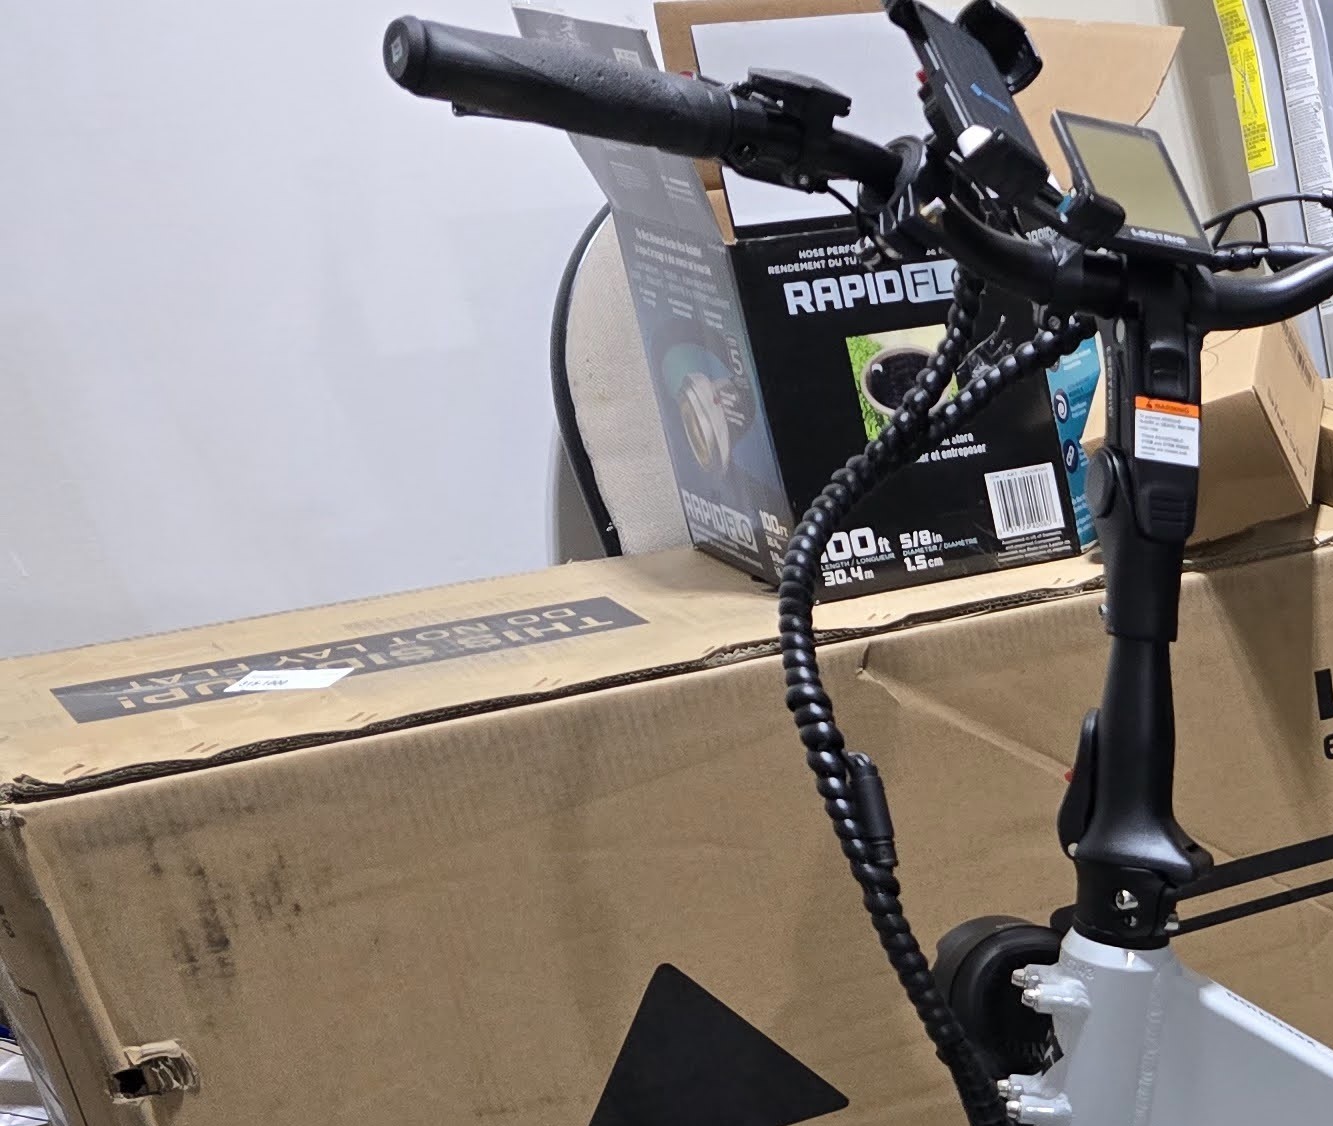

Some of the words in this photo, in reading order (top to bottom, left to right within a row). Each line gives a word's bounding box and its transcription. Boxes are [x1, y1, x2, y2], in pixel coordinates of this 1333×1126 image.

[799, 248, 824, 259] HOSE
[768, 258, 825, 275] RENDEMENT
[828, 257, 843, 268] DU
